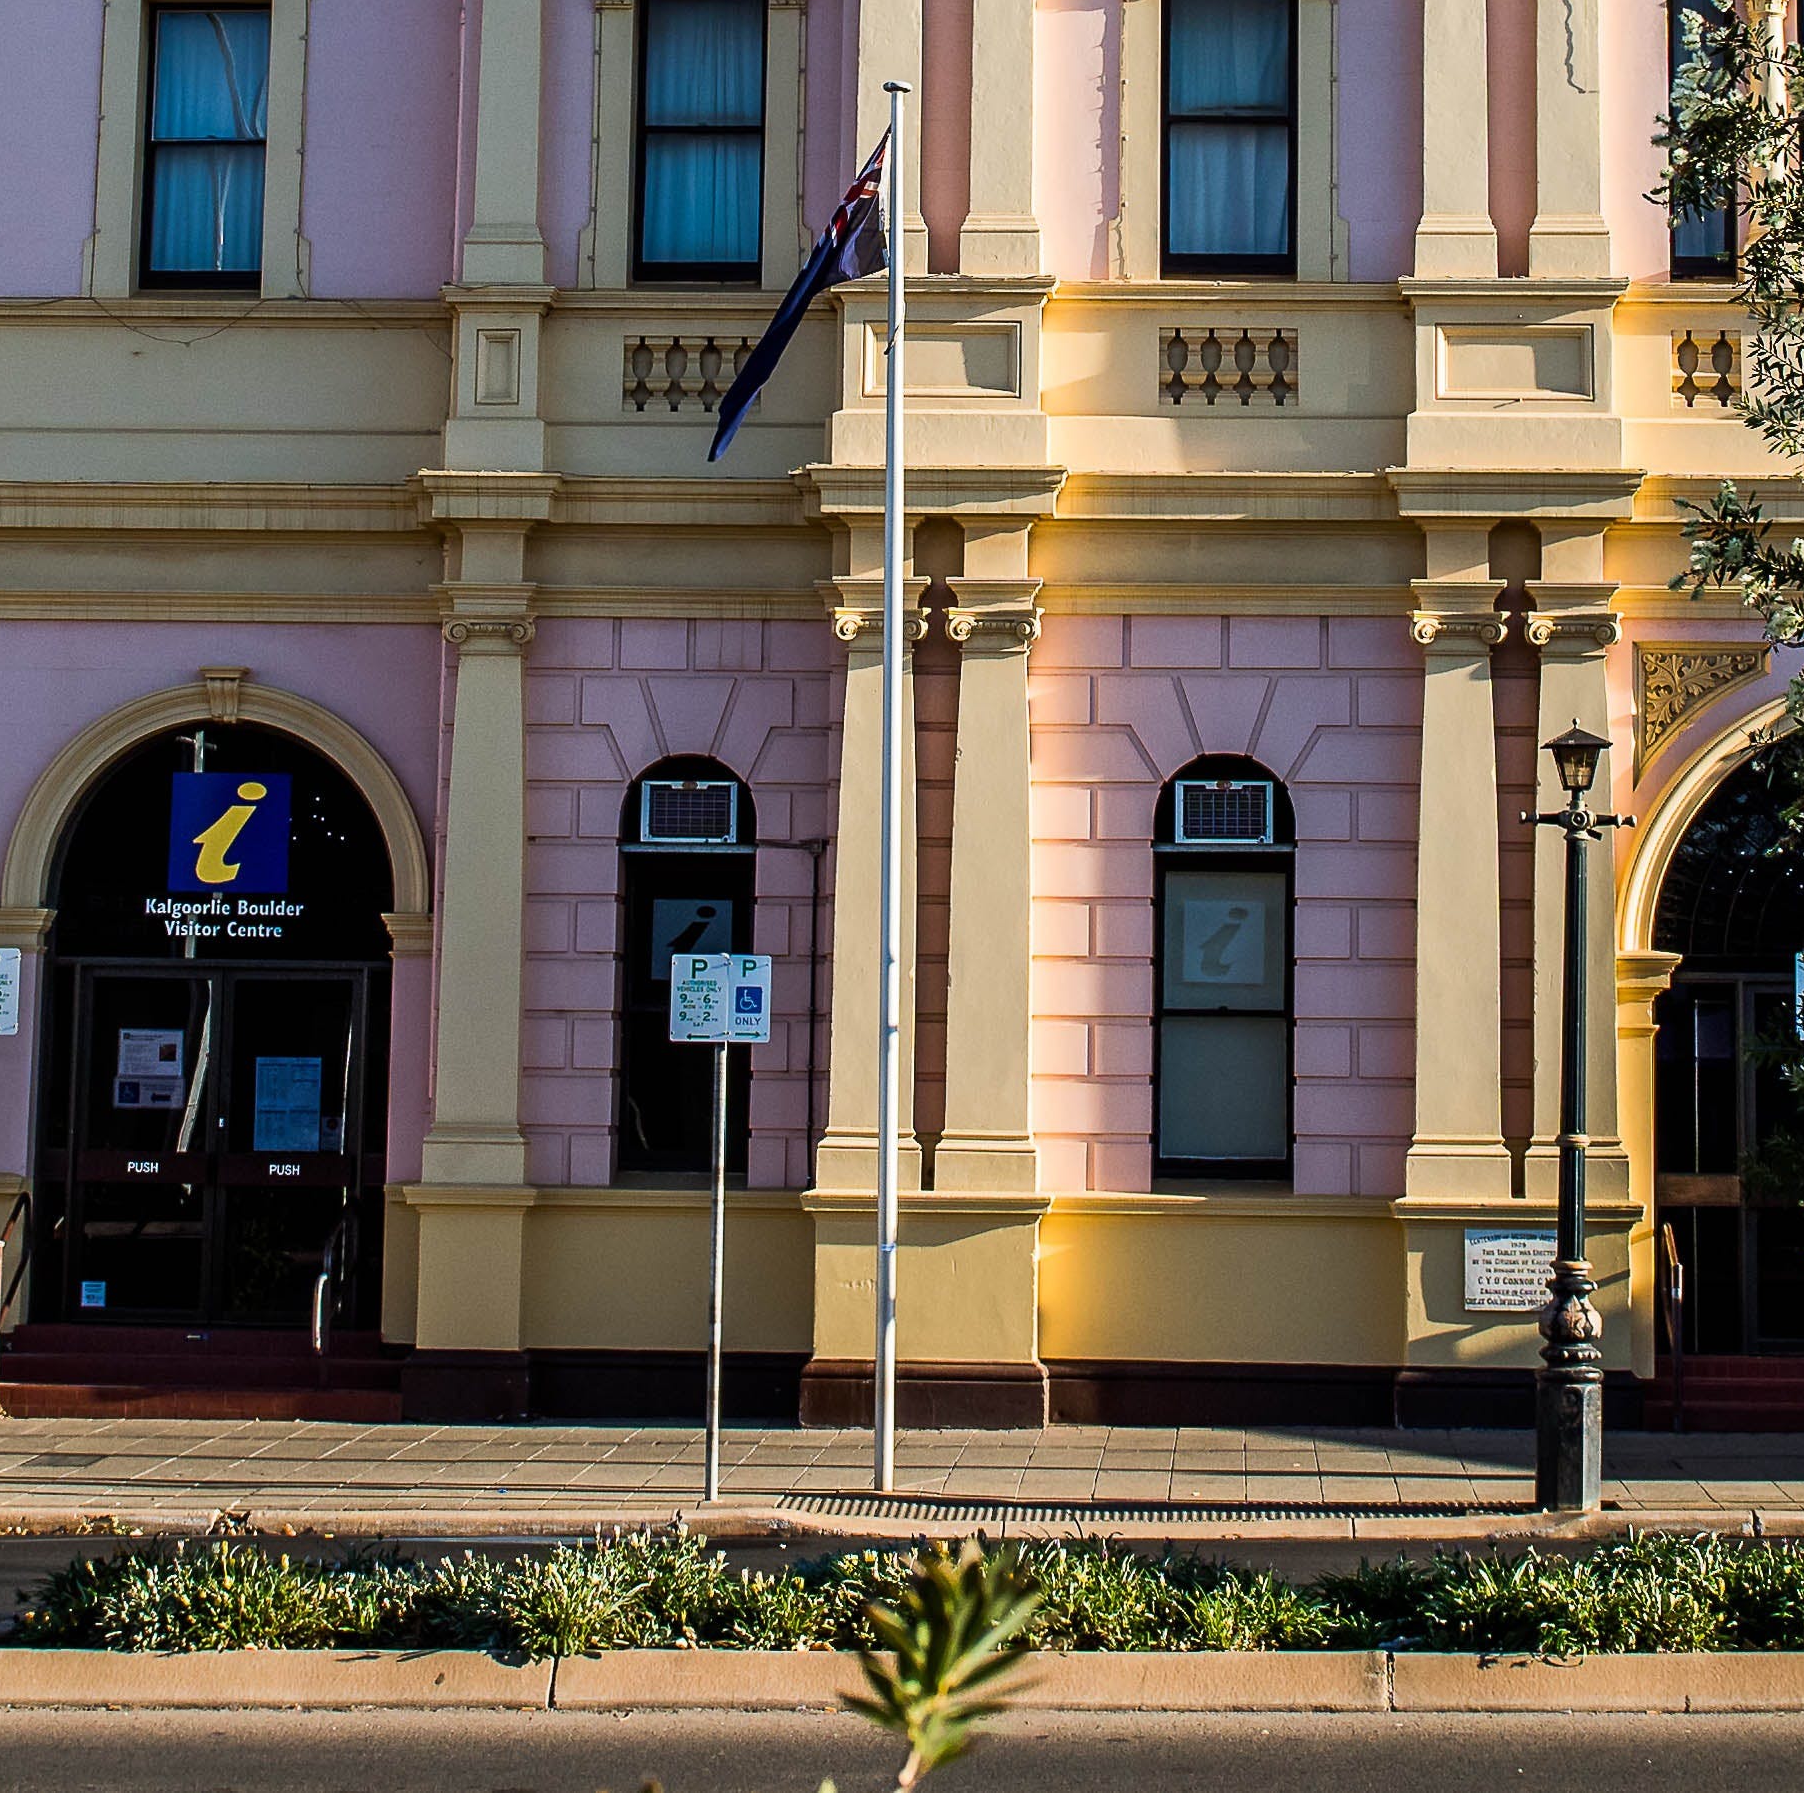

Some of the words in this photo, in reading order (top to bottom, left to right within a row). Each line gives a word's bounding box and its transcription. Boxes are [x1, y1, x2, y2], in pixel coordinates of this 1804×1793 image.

[145, 898, 230, 918] Kalgoorlie
[238, 900, 304, 916] Boulder
[164, 920, 220, 937] Visitor
[227, 921, 282, 938] Centre
[691, 959, 708, 978] P
[742, 959, 756, 977] P
[735, 1017, 762, 1026] ONLY
[127, 1161, 159, 1174] PUSH
[269, 1164, 300, 1176] PUSH
